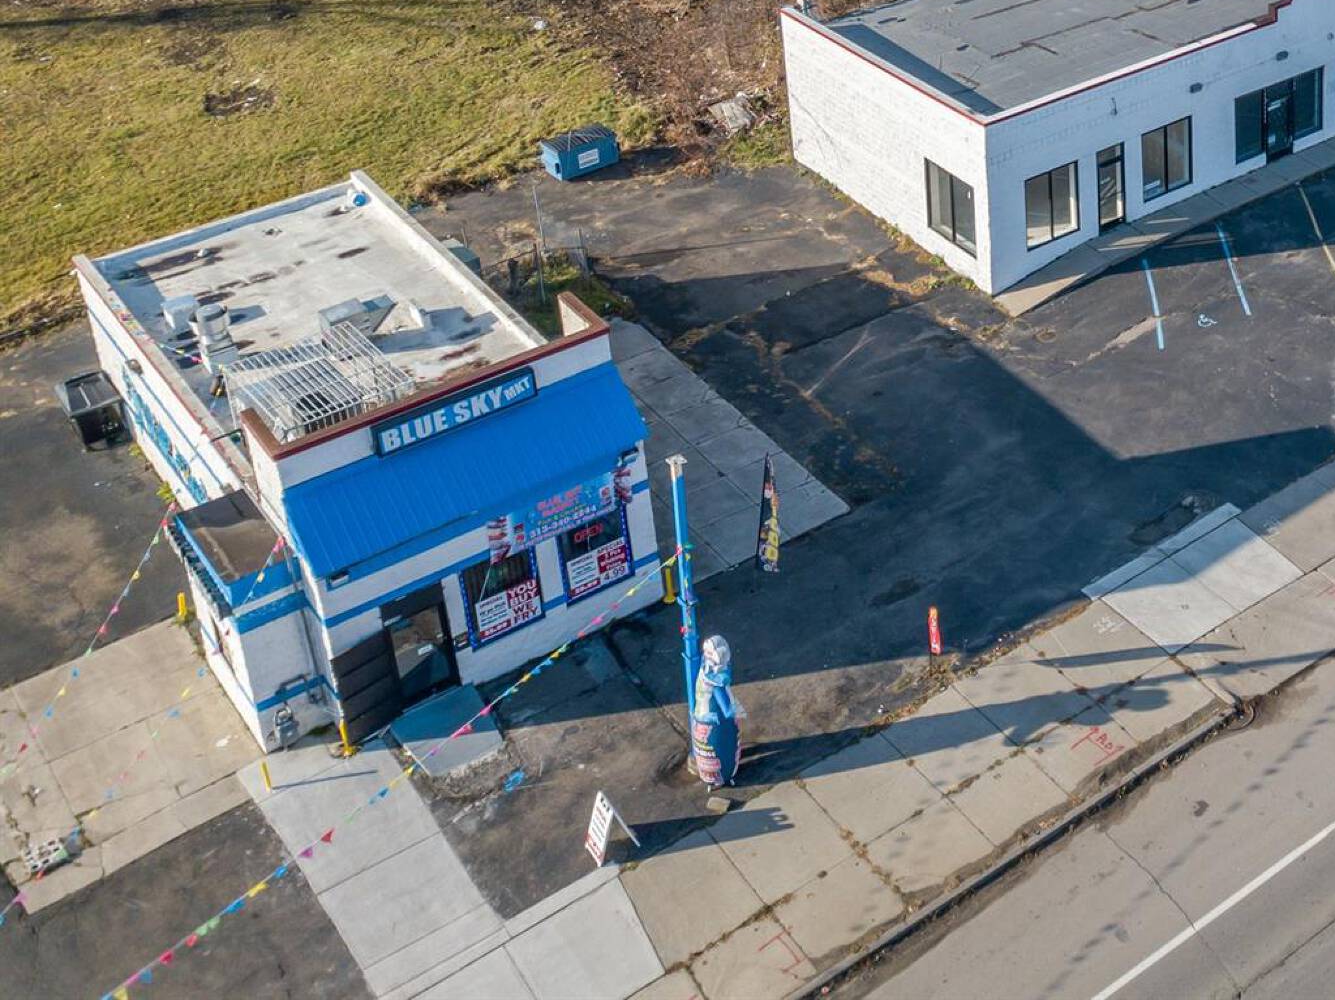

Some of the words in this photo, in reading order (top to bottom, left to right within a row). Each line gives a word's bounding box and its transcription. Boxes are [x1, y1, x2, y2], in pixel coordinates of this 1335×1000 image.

[381, 409, 448, 452] BLUE
[453, 386, 503, 424] SKY
[502, 377, 530, 401] MKT
[573, 523, 604, 543] OPEN
[508, 579, 537, 598] YOU
[510, 587, 538, 605] BUY
[512, 600, 532, 615] WE
[513, 606, 538, 624] FRY
